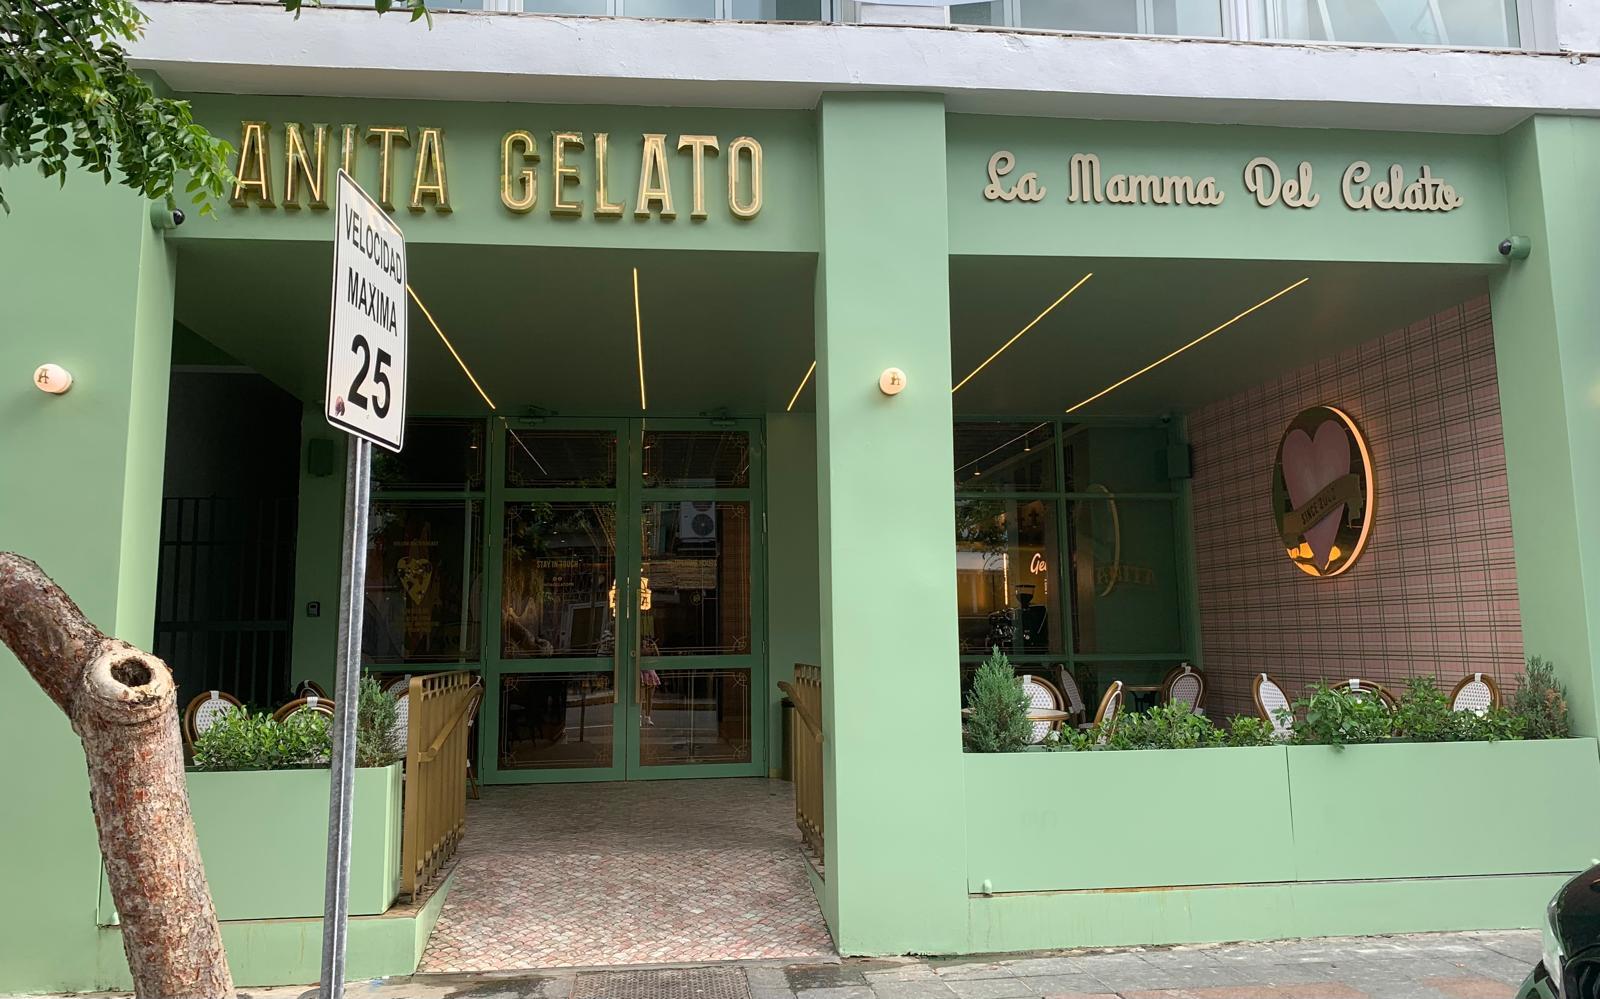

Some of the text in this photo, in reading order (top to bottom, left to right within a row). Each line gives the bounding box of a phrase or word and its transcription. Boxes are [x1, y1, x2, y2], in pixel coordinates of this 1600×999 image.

[500, 129, 763, 220] GELATO
[983, 151, 1464, 212] La Mamma Del Gelato
[345, 203, 403, 285] VELOCIDAD
[347, 266, 398, 337] MAXIMA
[347, 334, 392, 419] 25
[536, 560, 551, 568] STAY
